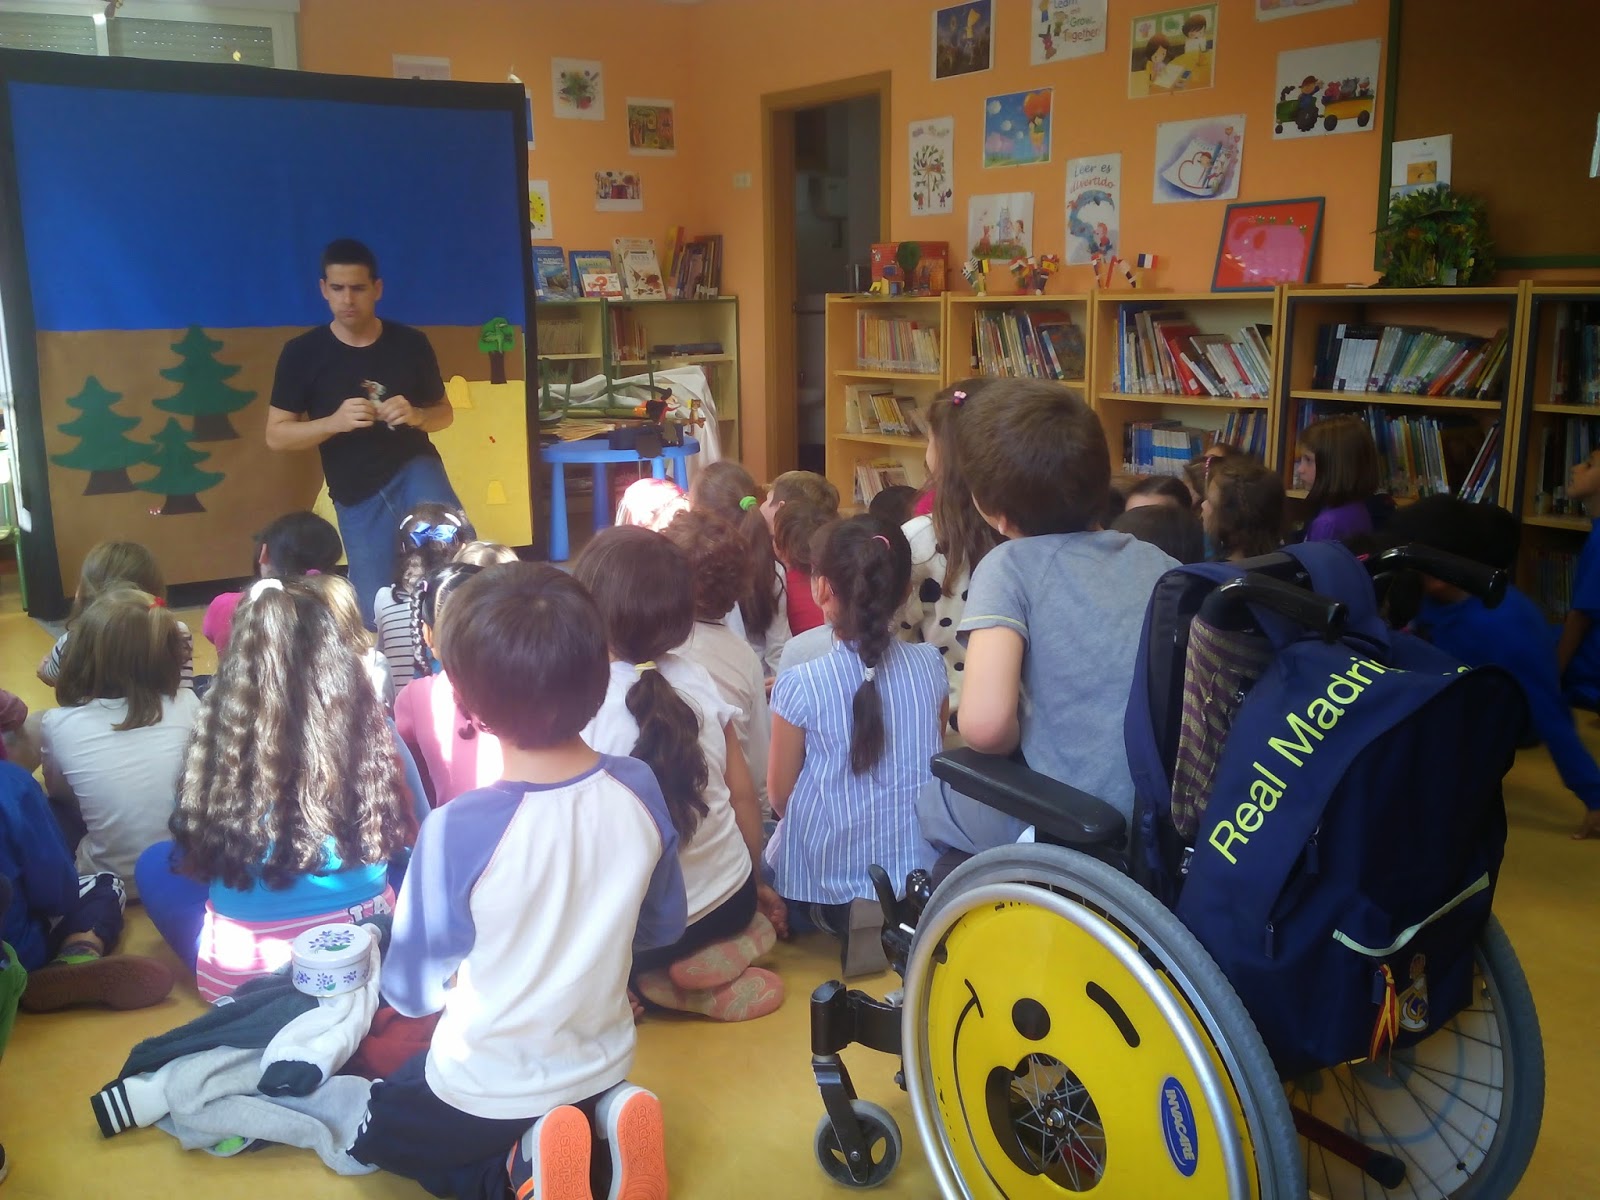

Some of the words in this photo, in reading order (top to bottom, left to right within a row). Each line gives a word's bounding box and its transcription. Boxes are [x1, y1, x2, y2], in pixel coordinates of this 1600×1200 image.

[1074, 163, 1097, 177] Leer
[1100, 164, 1112, 174] es
[1208, 761, 1287, 865] Real
[1267, 656, 1411, 768] Madri
[1164, 1089, 1195, 1160] INVACARE
